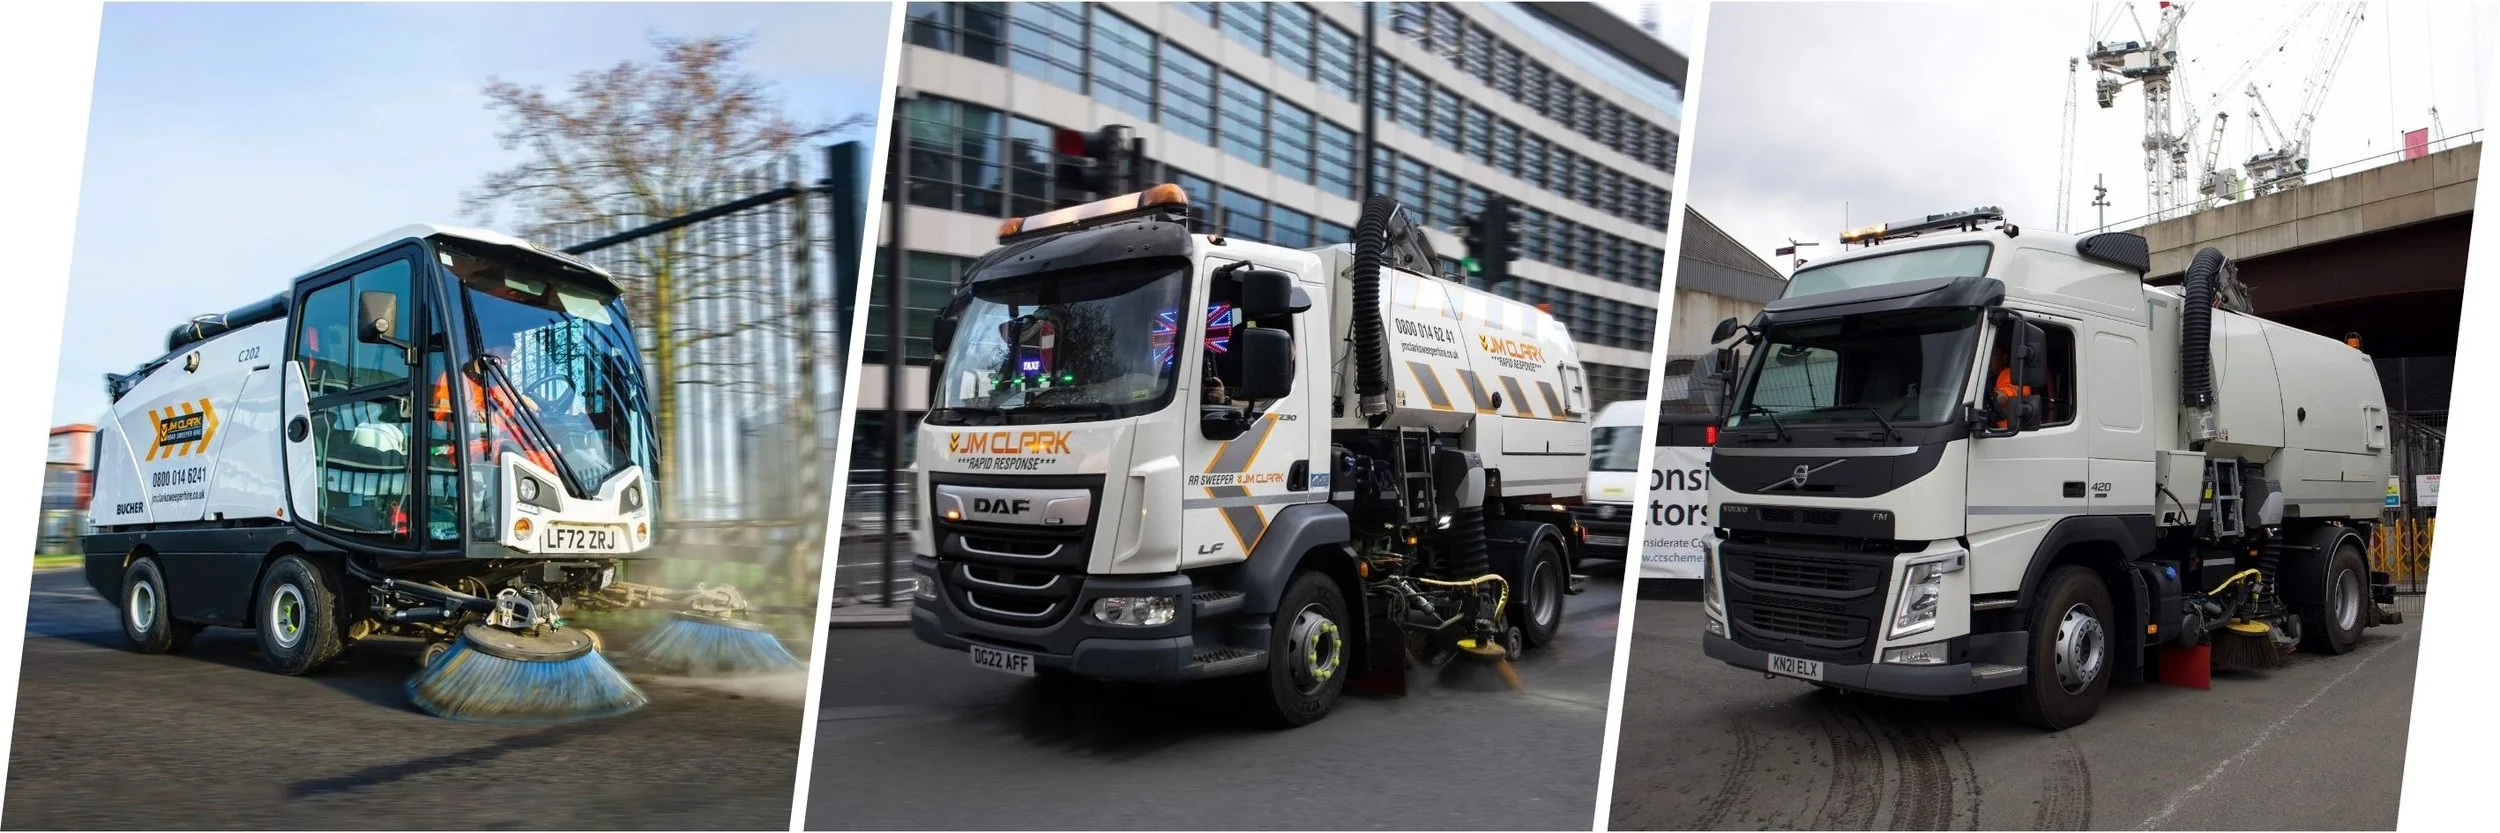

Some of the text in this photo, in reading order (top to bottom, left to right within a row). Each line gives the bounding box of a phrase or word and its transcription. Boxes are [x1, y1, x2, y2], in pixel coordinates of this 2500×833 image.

[1395, 318, 1455, 344] 0800 014 62 41
[238, 346, 260, 362] C202
[1490, 336, 1546, 363] JM CLARK
[167, 416, 202, 430] JM CLARK
[960, 431, 1073, 454] JM CLARK
[152, 466, 206, 487] 0800 014 6241
[1188, 472, 1284, 486] RR SWEEPER JM CLARK
[2091, 482, 2112, 491] 420
[117, 502, 144, 515] BUCHER
[974, 498, 1030, 515] DAF
[1723, 505, 1748, 513] VOLVO
[1873, 513, 1888, 521] FM
[547, 528, 615, 549] LF72 ZRJ
[1198, 543, 1224, 555] LF
[975, 648, 1028, 672] DG22 AFF
[1773, 655, 1817, 677] KN21 ELX
